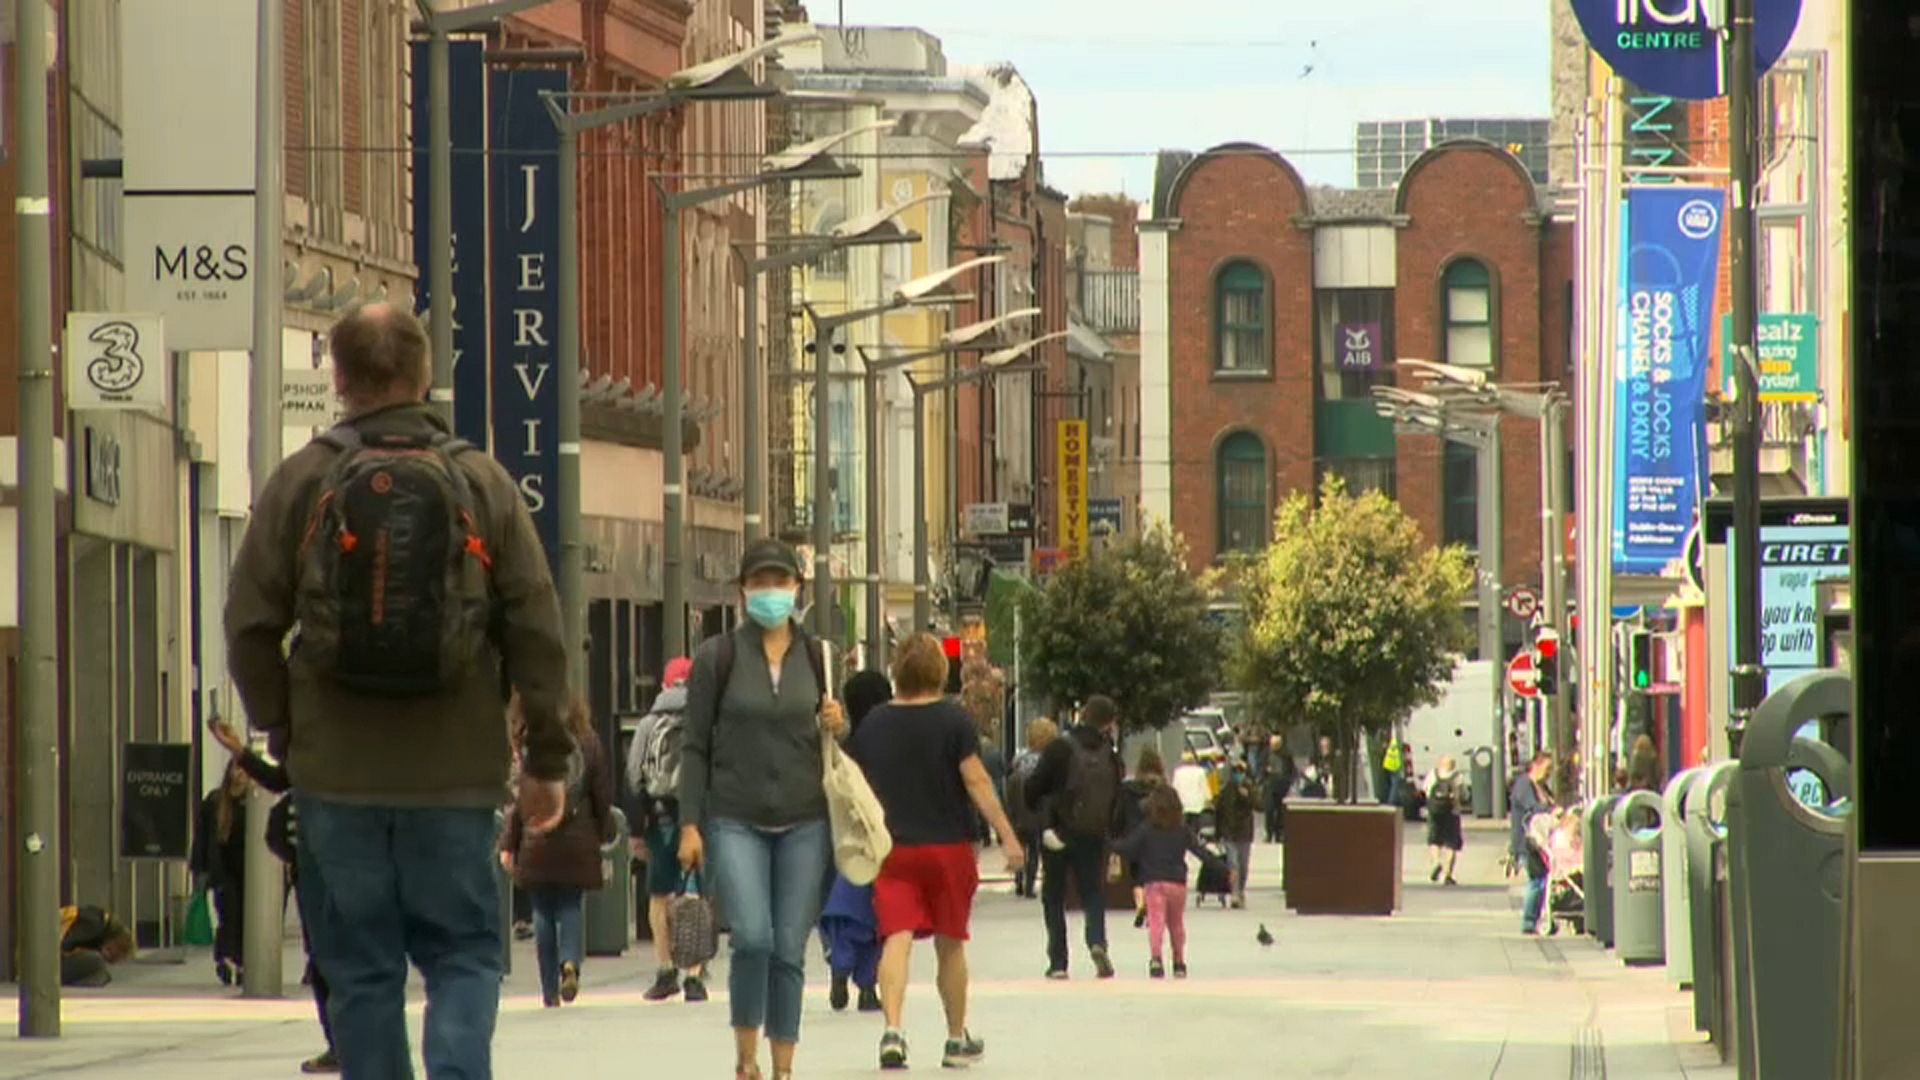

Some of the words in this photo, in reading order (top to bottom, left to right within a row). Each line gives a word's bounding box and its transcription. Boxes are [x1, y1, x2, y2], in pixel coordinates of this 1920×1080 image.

[1617, 31, 1702, 49] CENTRE
[155, 245, 248, 281] M&S
[513, 163, 549, 514] JERVIS
[1631, 290, 1651, 378] CHANEL
[1653, 290, 1673, 364] SOCKS
[87, 321, 144, 392] 3
[1343, 351, 1372, 366] AIB
[1652, 367, 1673, 384] &
[1631, 400, 1651, 460] DKNY
[1780, 629, 1815, 653] with
[127, 770, 184, 784] ENTRANCE
[139, 785, 172, 797] ONLY
